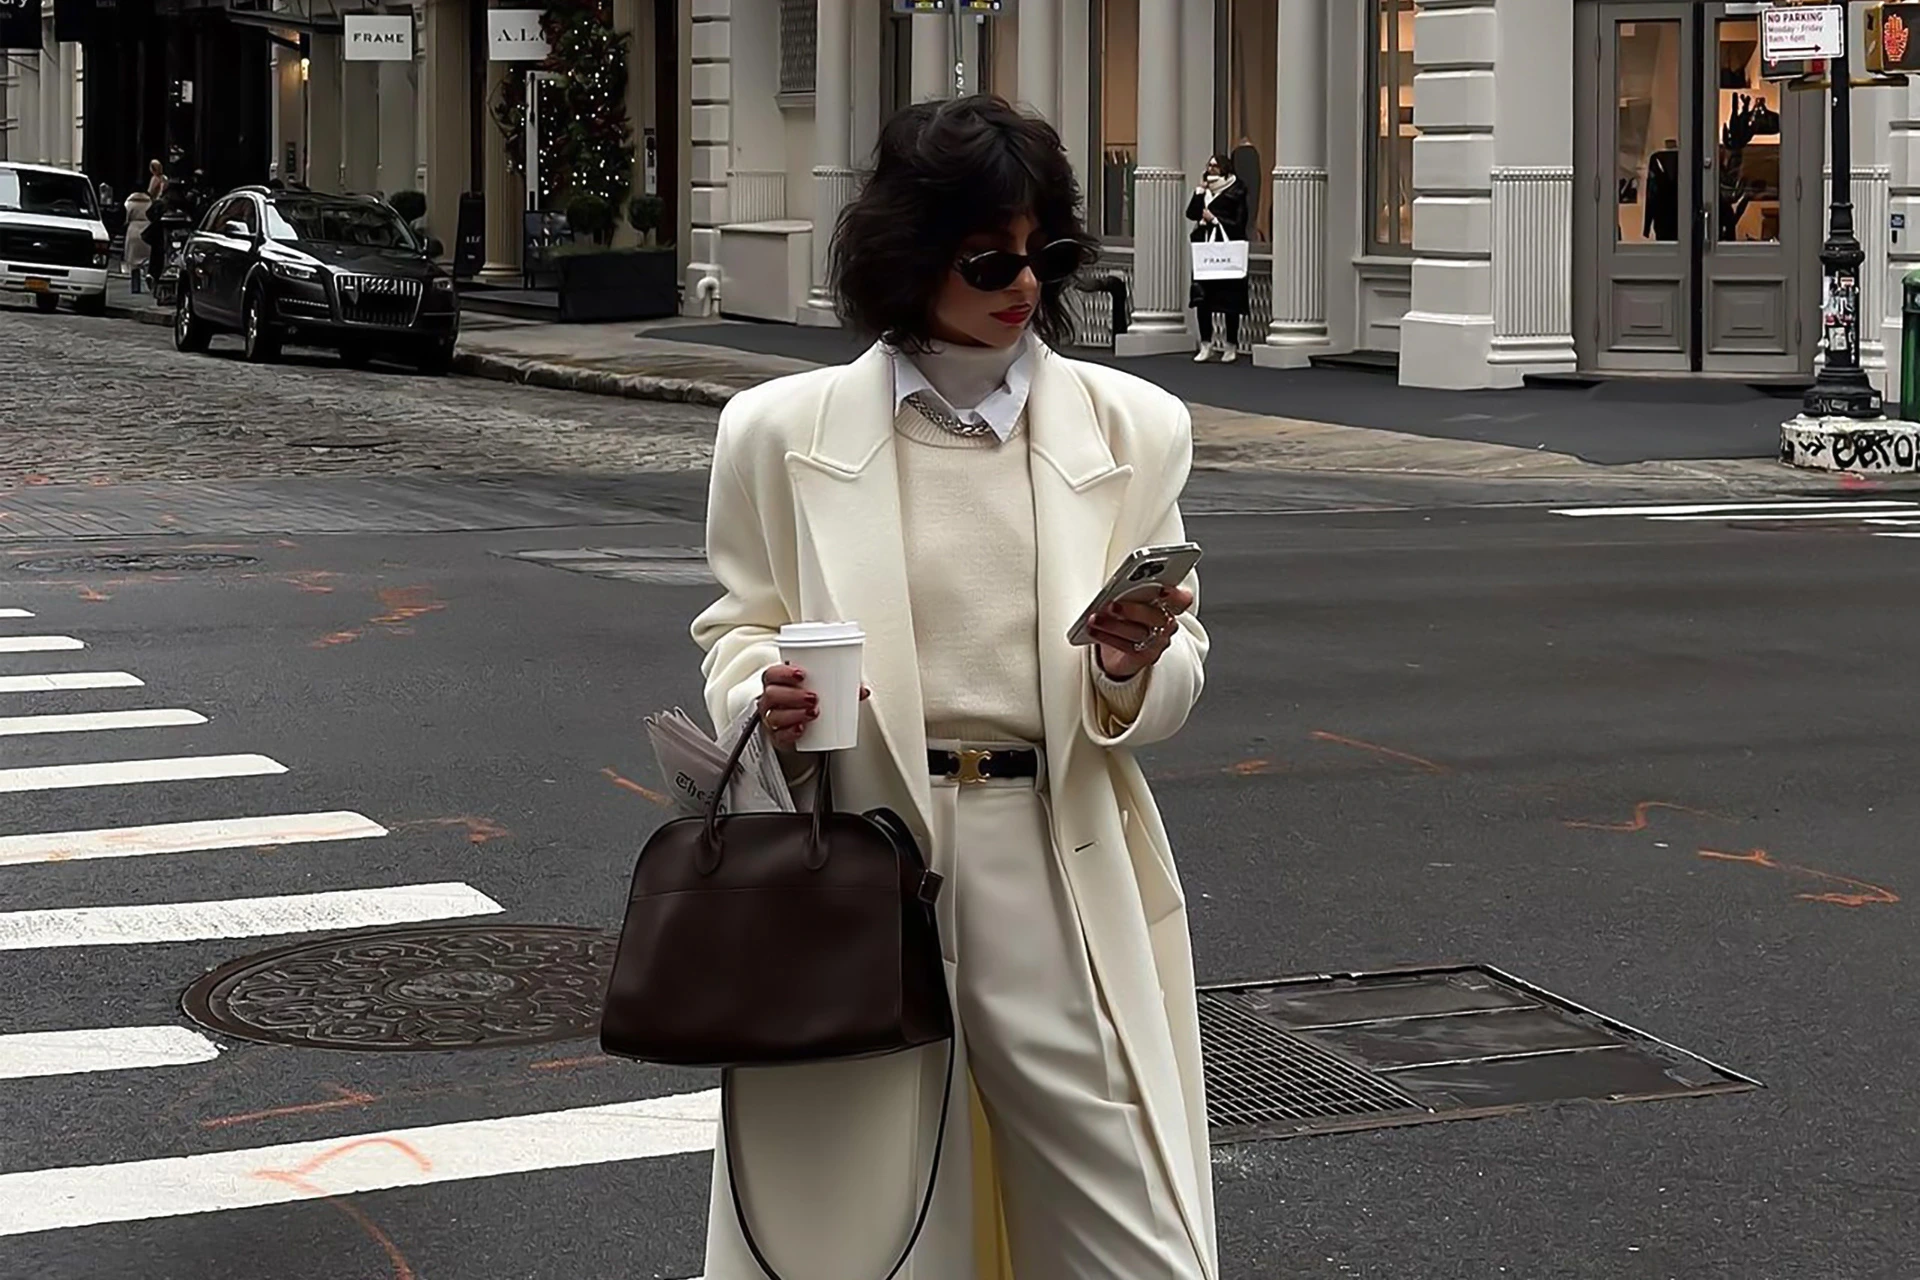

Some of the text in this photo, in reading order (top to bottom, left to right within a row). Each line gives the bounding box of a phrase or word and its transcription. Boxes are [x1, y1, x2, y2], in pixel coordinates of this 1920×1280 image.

[1768, 12, 1823, 23] NO PARKING
[353, 32, 404, 43] FRAME
